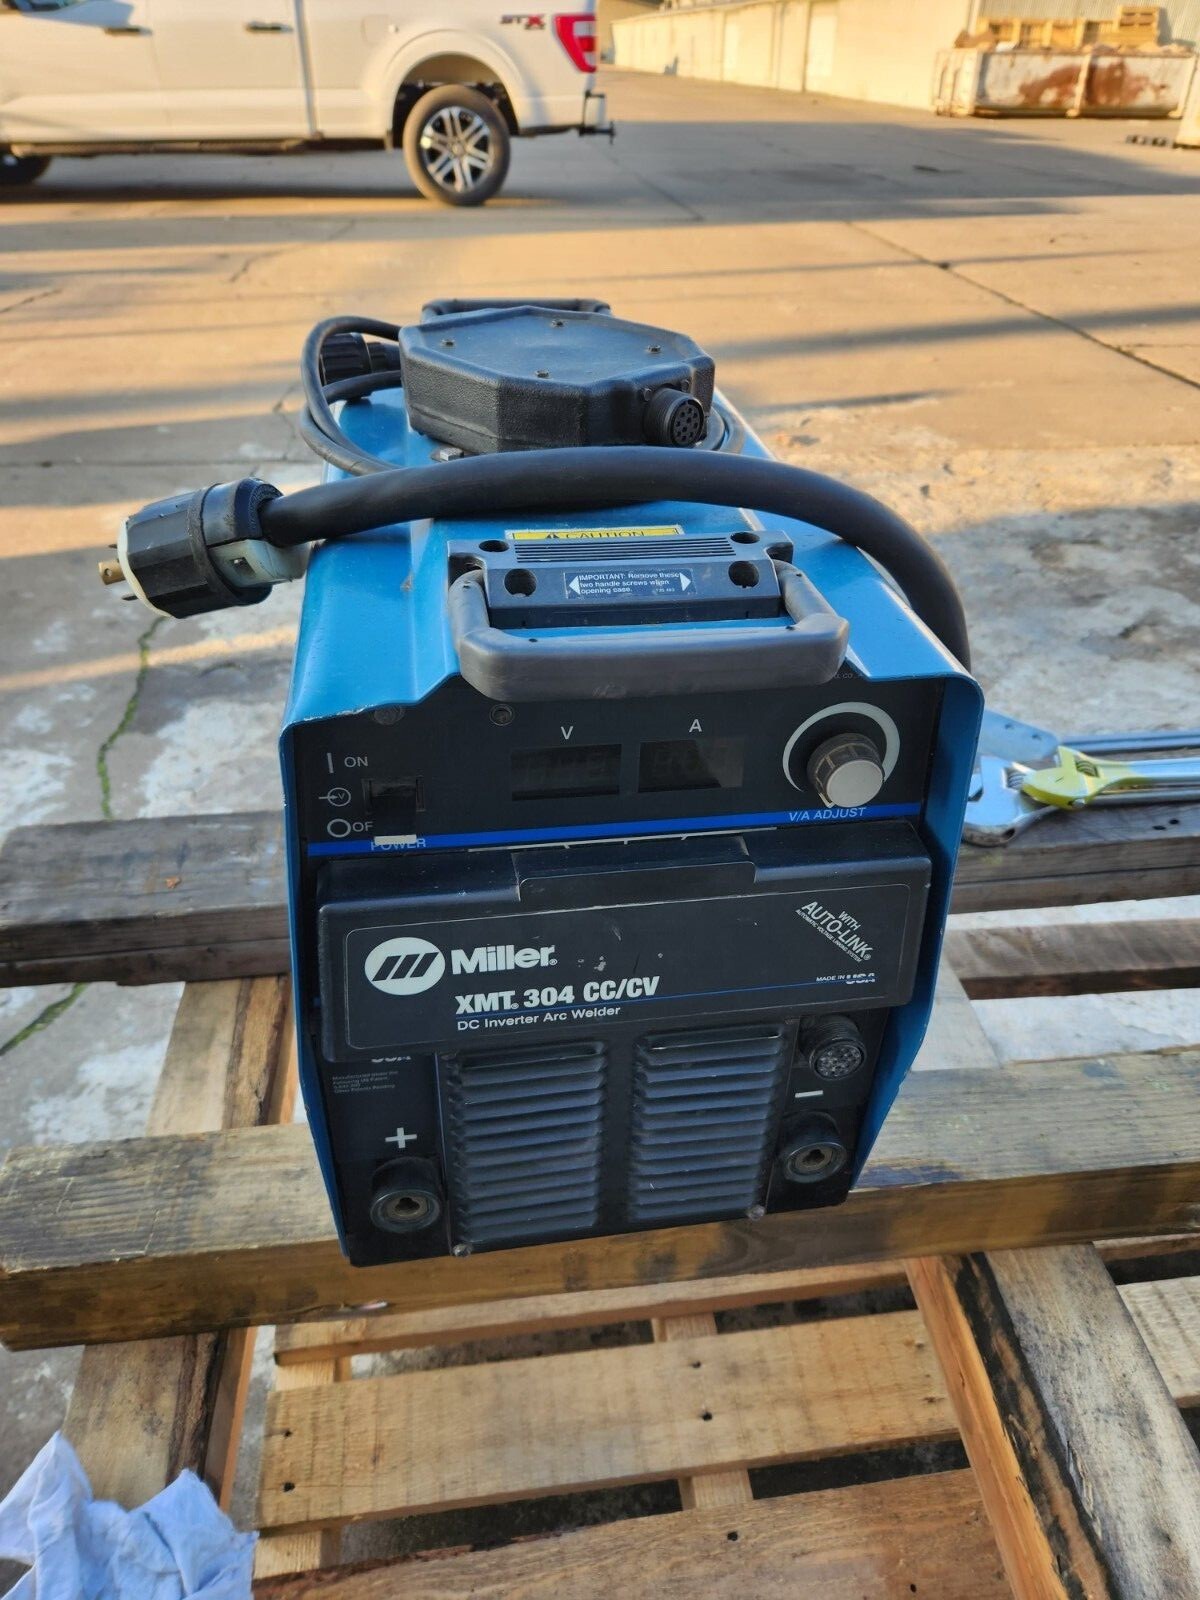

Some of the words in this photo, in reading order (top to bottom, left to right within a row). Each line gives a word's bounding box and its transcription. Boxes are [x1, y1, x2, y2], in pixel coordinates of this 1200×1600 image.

[580, 587, 611, 595] opening
[560, 726, 573, 740] V
[689, 718, 703, 733] A
[344, 756, 368, 768] ON
[788, 810, 810, 822] V/A
[813, 806, 867, 819] ADJUST
[352, 821, 374, 832] OF
[838, 911, 861, 931] WITH
[523, 985, 575, 1008] 304
[583, 975, 660, 1002] CC/CV
[457, 1019, 480, 1031] DC
[484, 1015, 540, 1028] Inverter
[543, 1012, 567, 1023] Arc
[571, 1006, 621, 1019] Welder
